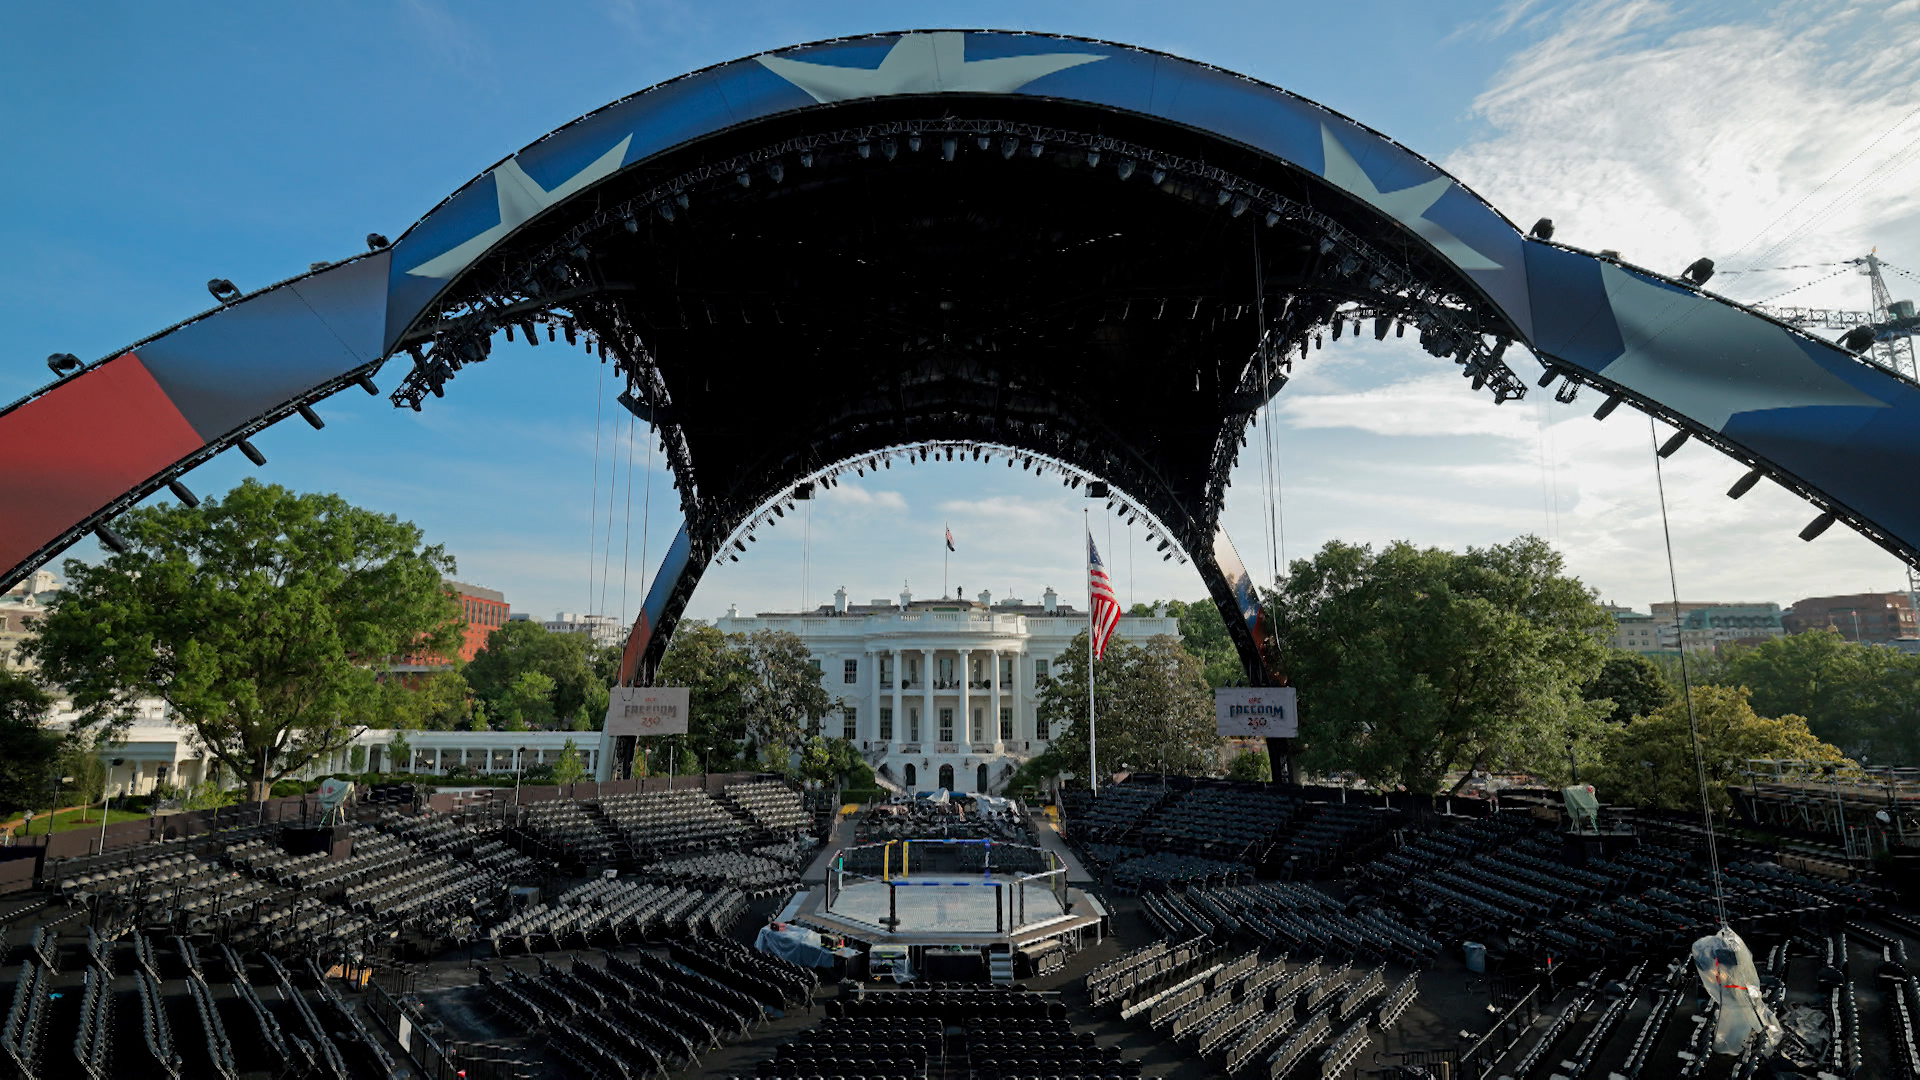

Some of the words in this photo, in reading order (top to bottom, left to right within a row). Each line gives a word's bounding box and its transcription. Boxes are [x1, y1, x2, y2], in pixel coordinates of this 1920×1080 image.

[624, 705, 677, 718] FREEDOM
[1229, 705, 1284, 719] FREEDOM
[1247, 717, 1267, 730] 250
